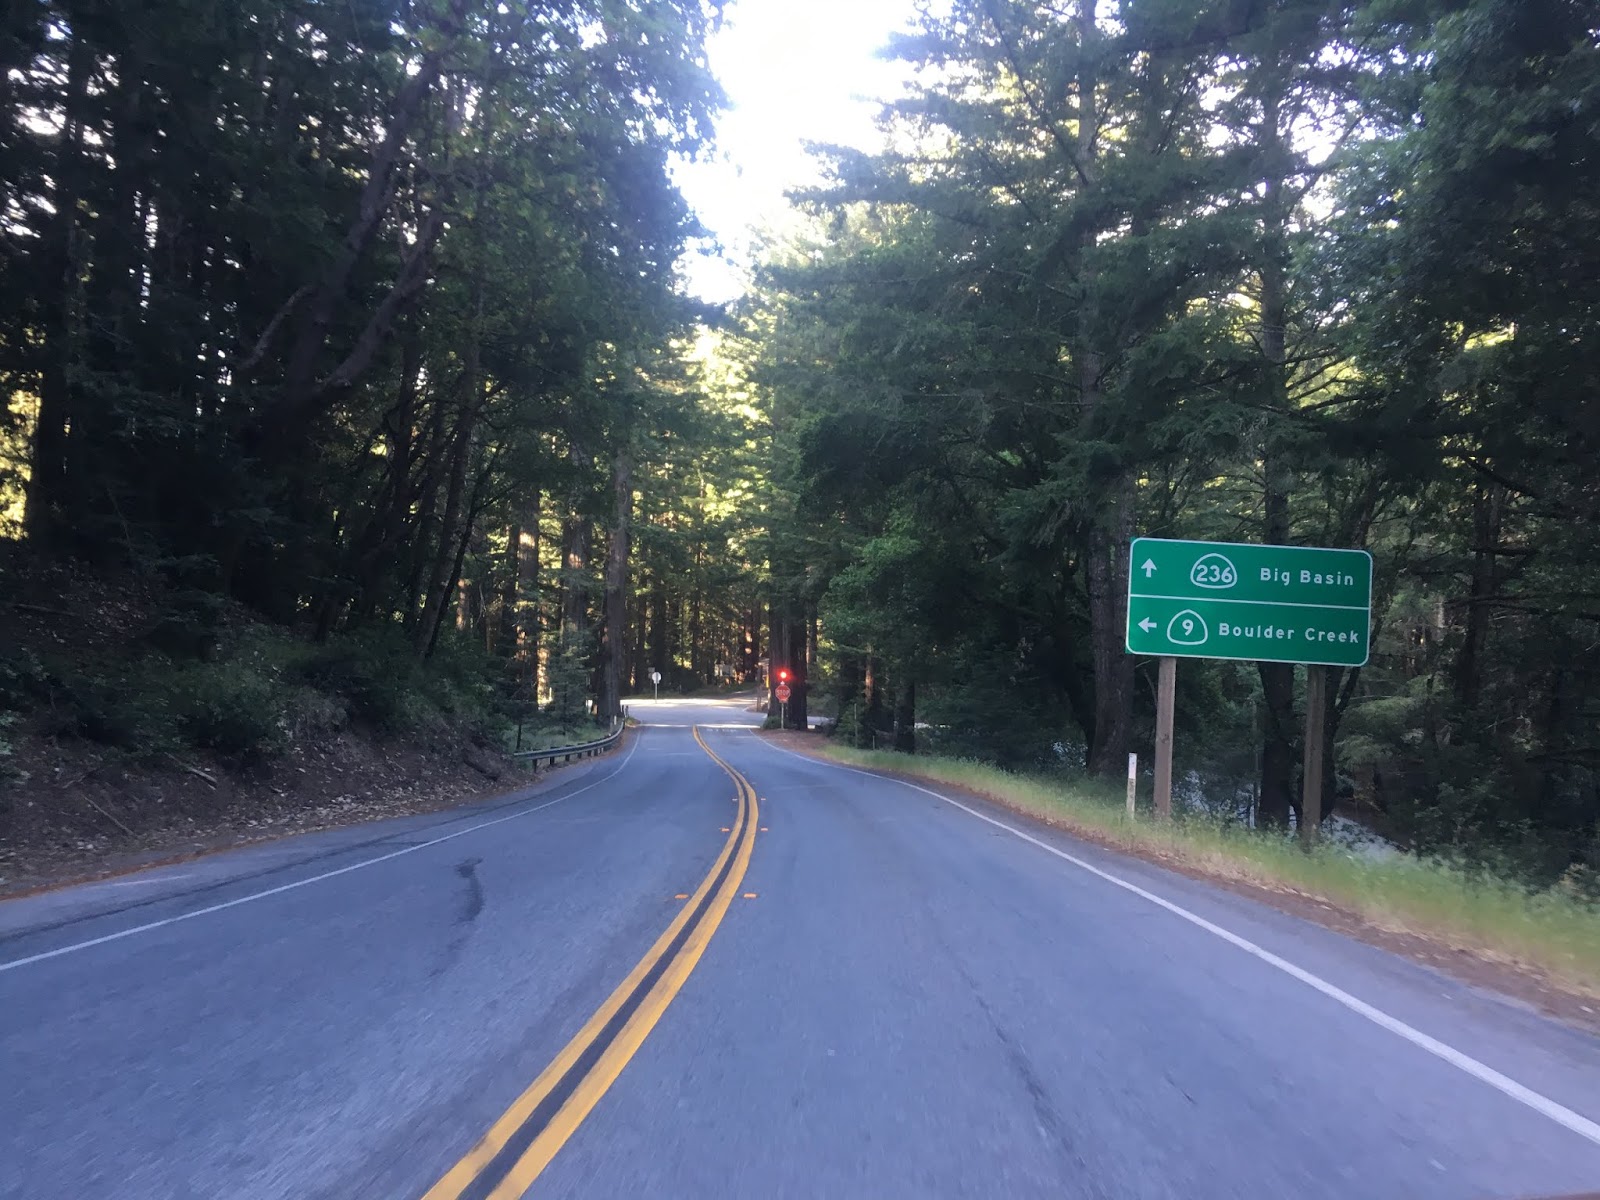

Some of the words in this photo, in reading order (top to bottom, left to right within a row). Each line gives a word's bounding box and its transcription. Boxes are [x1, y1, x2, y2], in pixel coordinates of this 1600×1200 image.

[1196, 564, 1234, 583] 236
[1260, 567, 1291, 586] Big
[1300, 572, 1354, 586] Basin
[1181, 619, 1194, 636] 9
[1218, 623, 1295, 640] Boulder
[1304, 627, 1359, 643] Creek
